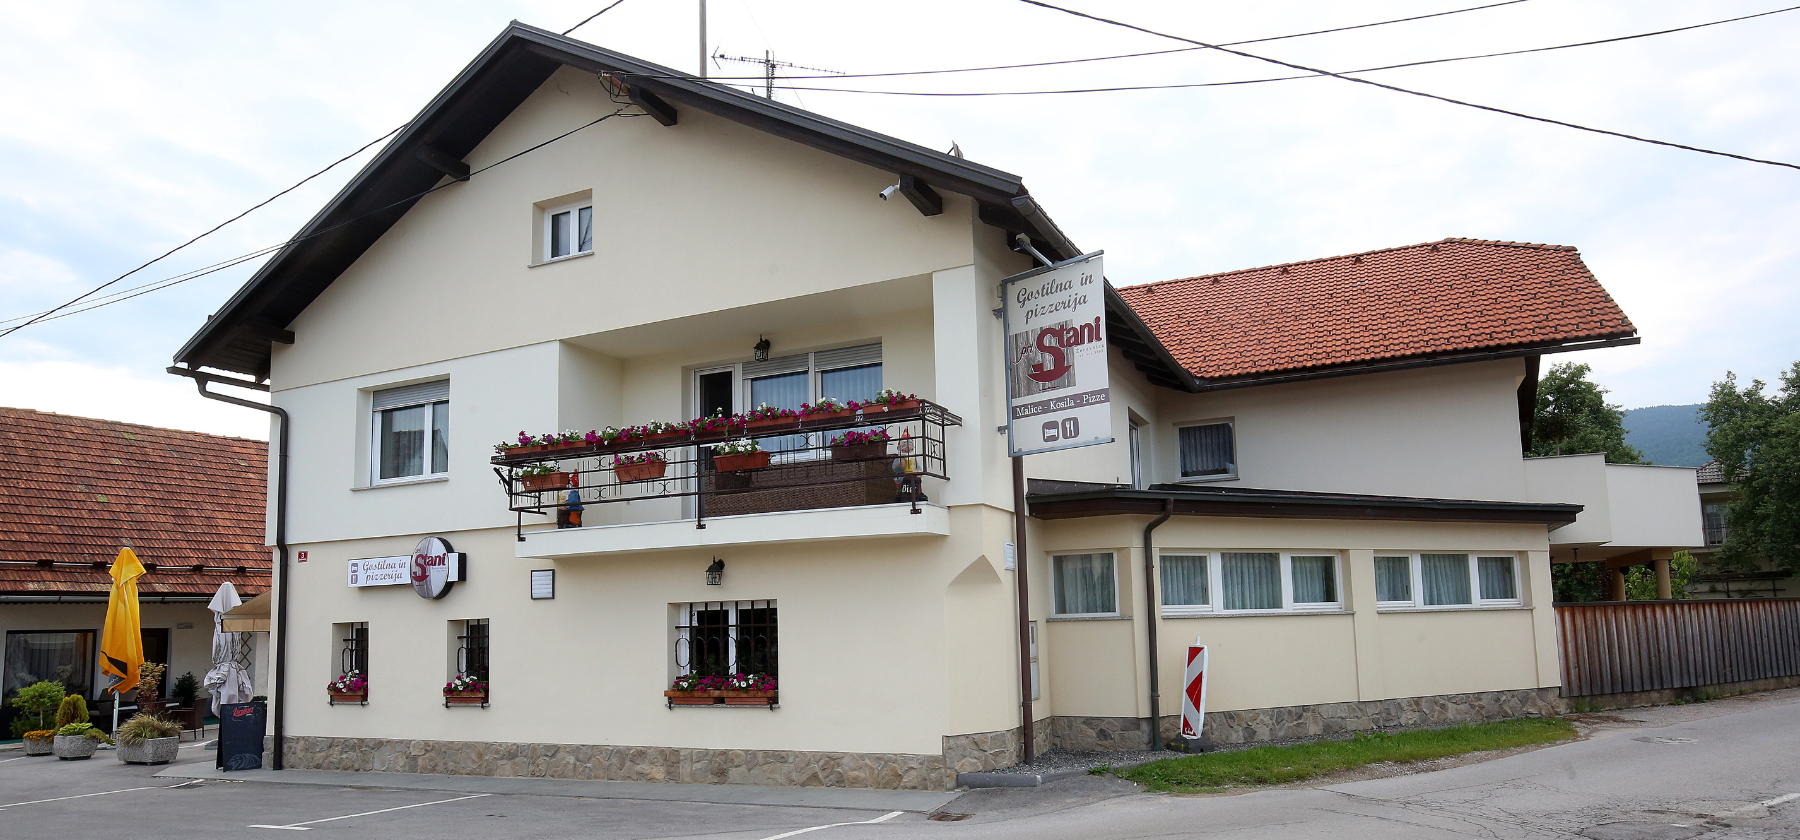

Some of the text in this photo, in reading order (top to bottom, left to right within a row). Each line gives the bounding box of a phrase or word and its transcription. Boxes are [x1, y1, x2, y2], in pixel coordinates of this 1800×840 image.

[1017, 272, 1094, 308] Gostilna in
[1025, 293, 1088, 325] pizzerija
[1027, 316, 1102, 382] Stani
[1016, 405, 1042, 417] Malice
[1050, 397, 1075, 410] Kosila
[1083, 392, 1106, 404] Pizze
[362, 559, 406, 574] Gostilna in
[365, 570, 403, 584] pizzerija
[411, 552, 447, 582] Stani
